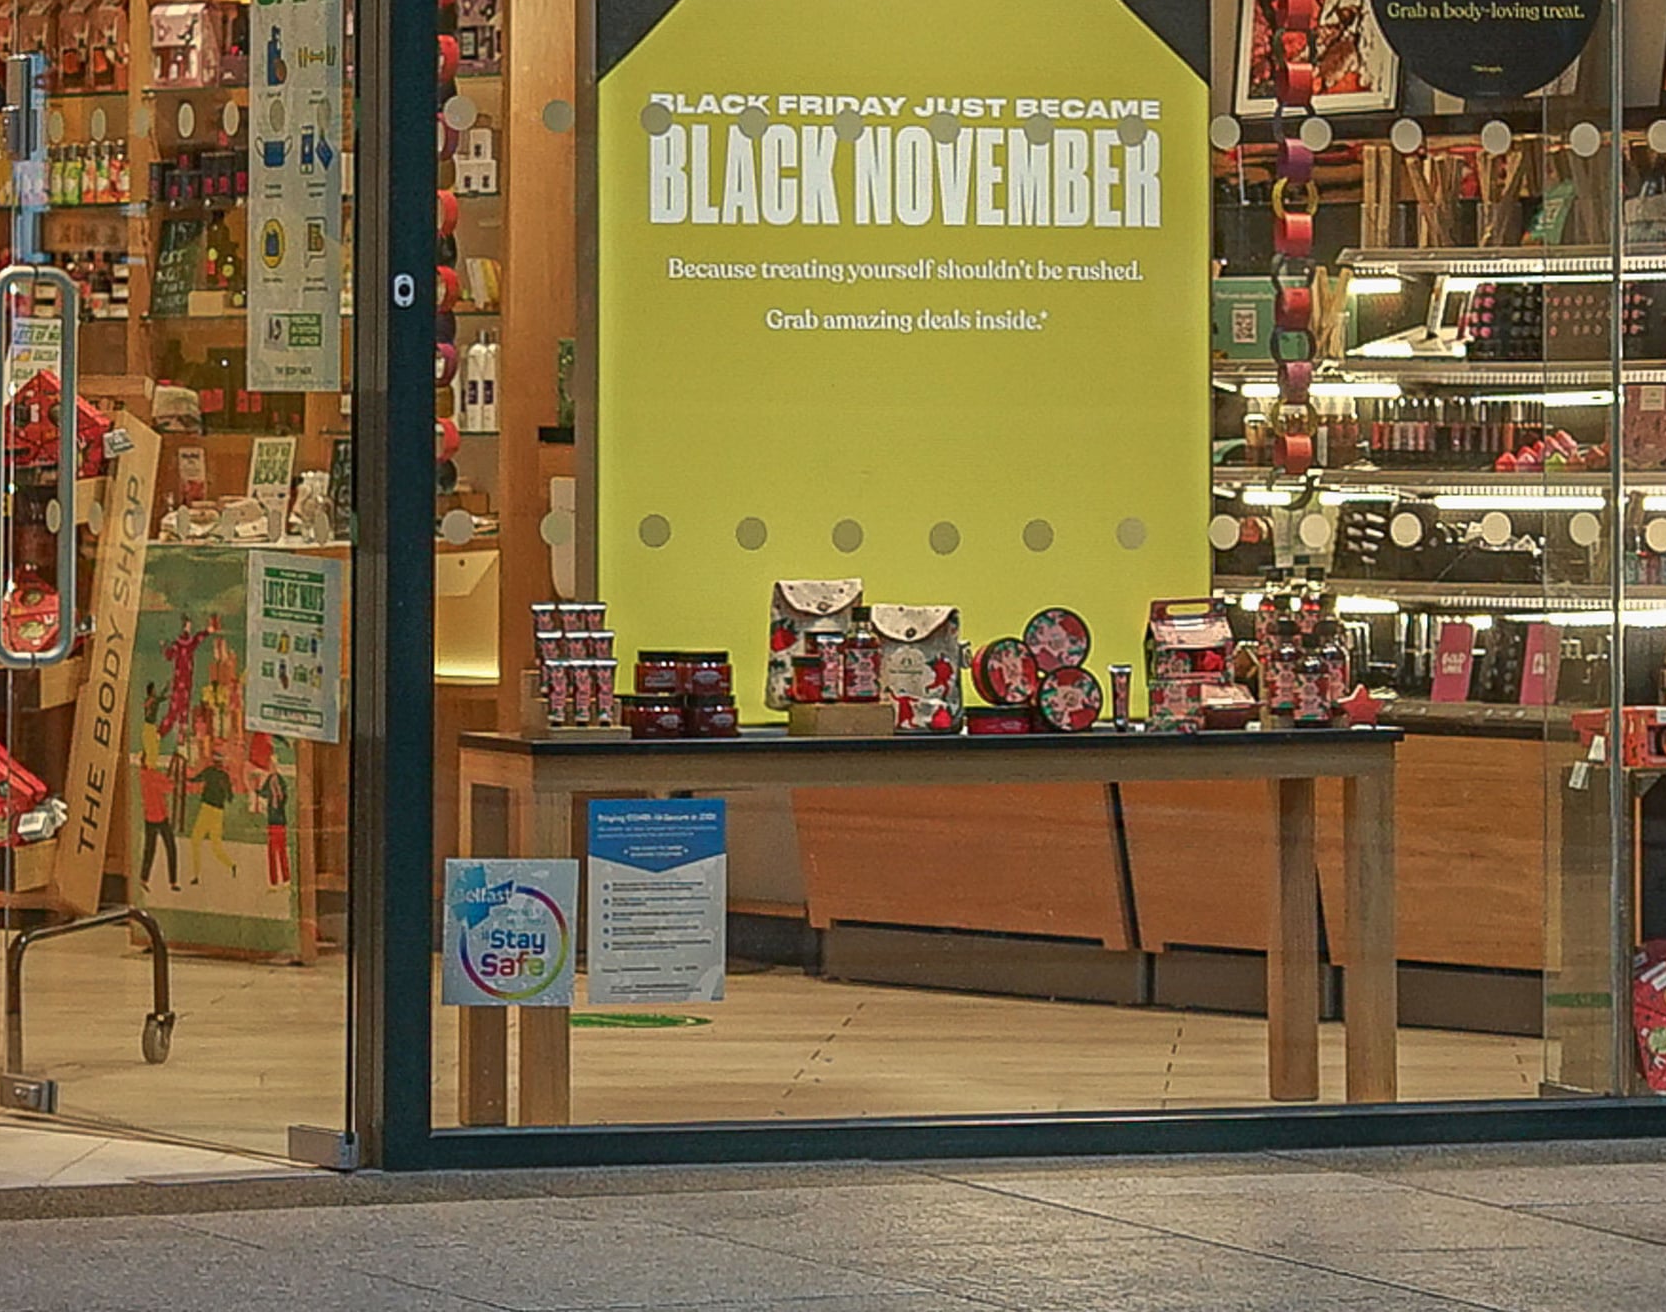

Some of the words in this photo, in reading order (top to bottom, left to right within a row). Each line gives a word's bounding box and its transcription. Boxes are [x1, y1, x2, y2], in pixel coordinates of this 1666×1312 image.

[1386, 1, 1428, 19] Grab
[1430, 6, 1441, 19] a
[1442, 1, 1541, 23] body-loving
[1543, 3, 1586, 20] treat.
[649, 92, 771, 116] BLACK
[777, 94, 908, 117] FRIDAY
[913, 96, 1008, 118] JUST
[1015, 98, 1162, 121] BECAME
[649, 124, 841, 225] BLACK
[854, 124, 1162, 228] NOVEMBER
[667, 257, 757, 280] Because
[761, 259, 845, 283] treating
[846, 258, 935, 284] yourself
[937, 259, 1034, 280] shouldn't
[1037, 259, 1064, 280] be
[1066, 259, 1145, 281] rushed.
[765, 308, 820, 330] Grab
[822, 309, 913, 334] amazing
[916, 308, 972, 330] deals
[76, 762, 106, 856] THE
[93, 624, 127, 749] BODY
[113, 473, 146, 608] SHOP
[480, 951, 546, 978] Safe
